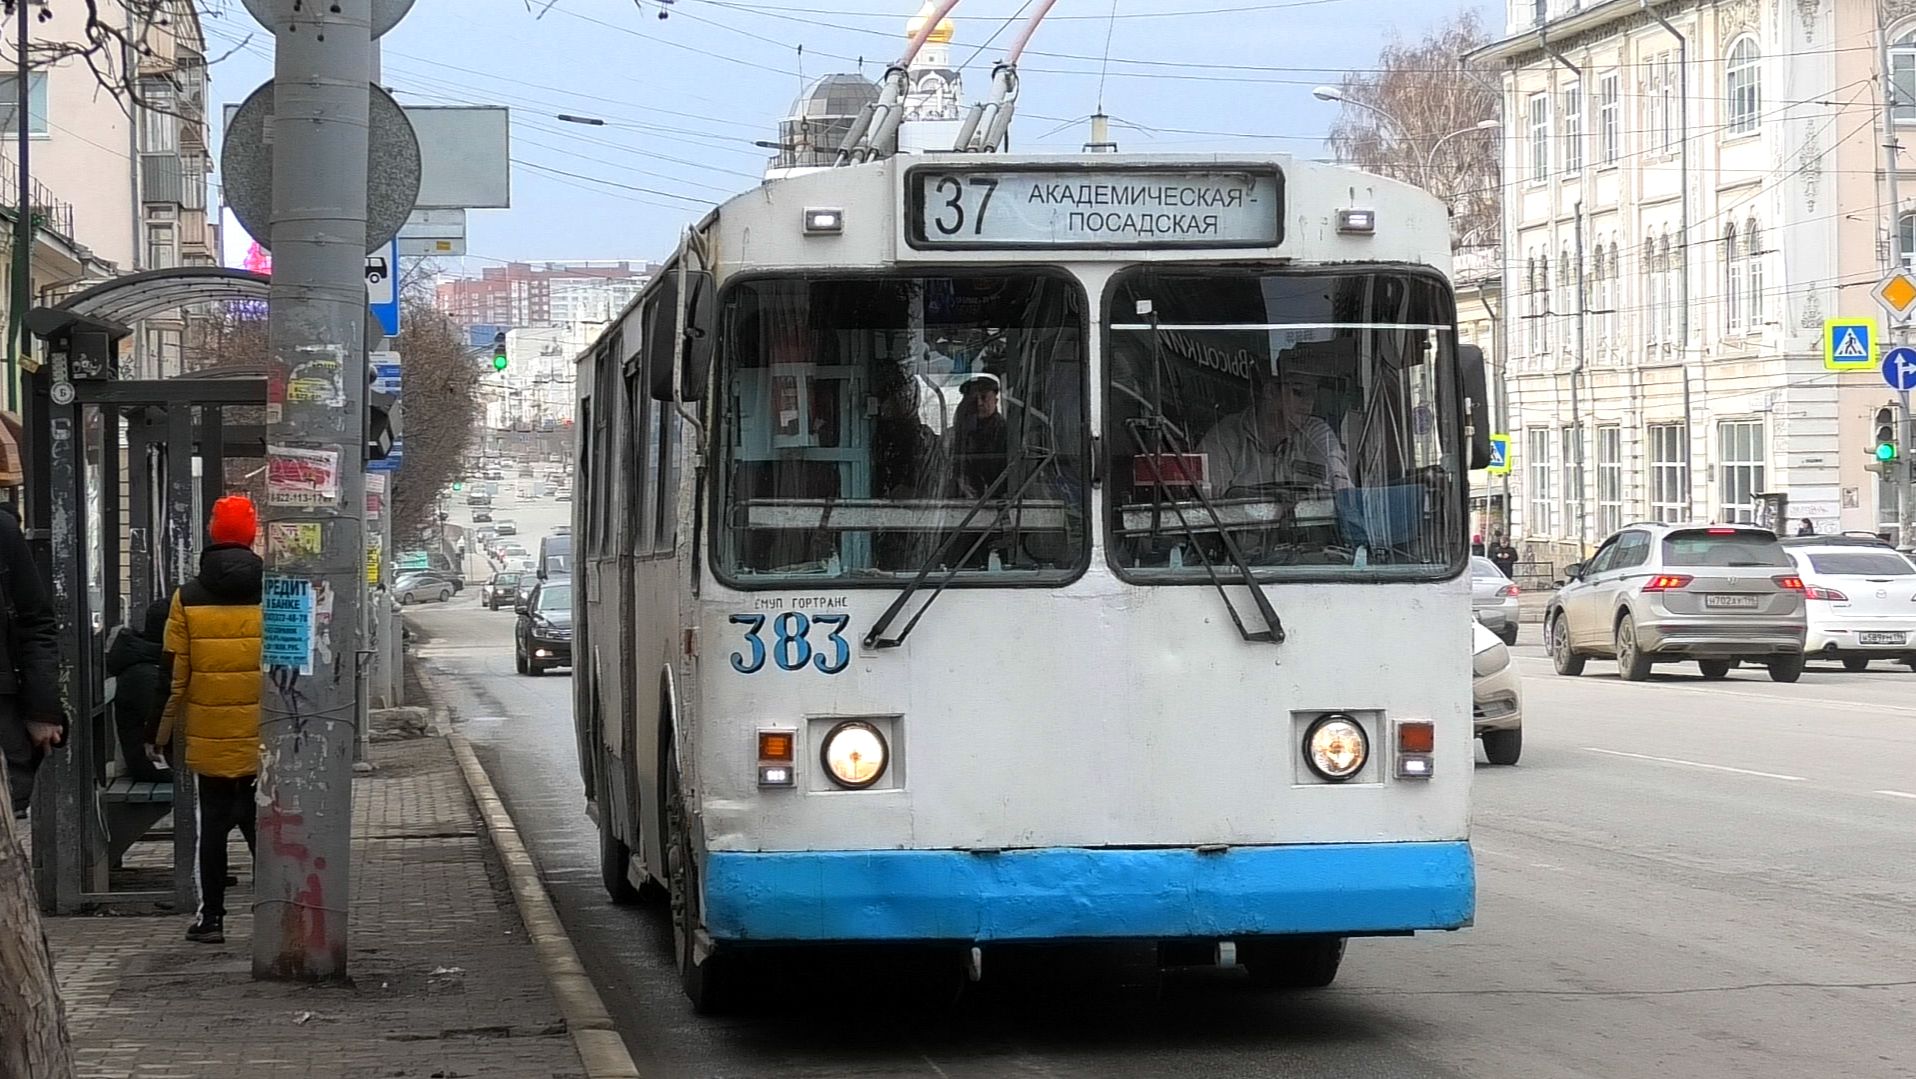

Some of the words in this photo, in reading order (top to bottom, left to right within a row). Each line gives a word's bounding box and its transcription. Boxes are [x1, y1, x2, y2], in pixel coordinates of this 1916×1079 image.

[935, 177, 998, 235] 37
[1028, 184, 1242, 208] АКАДЕМИЧЕСКАЯ
[1068, 212, 1218, 236] ПОСАДСКАЯ
[754, 598, 783, 609] ЕМУП
[792, 596, 849, 609] ГОРТРАНС
[729, 611, 850, 675] 383
